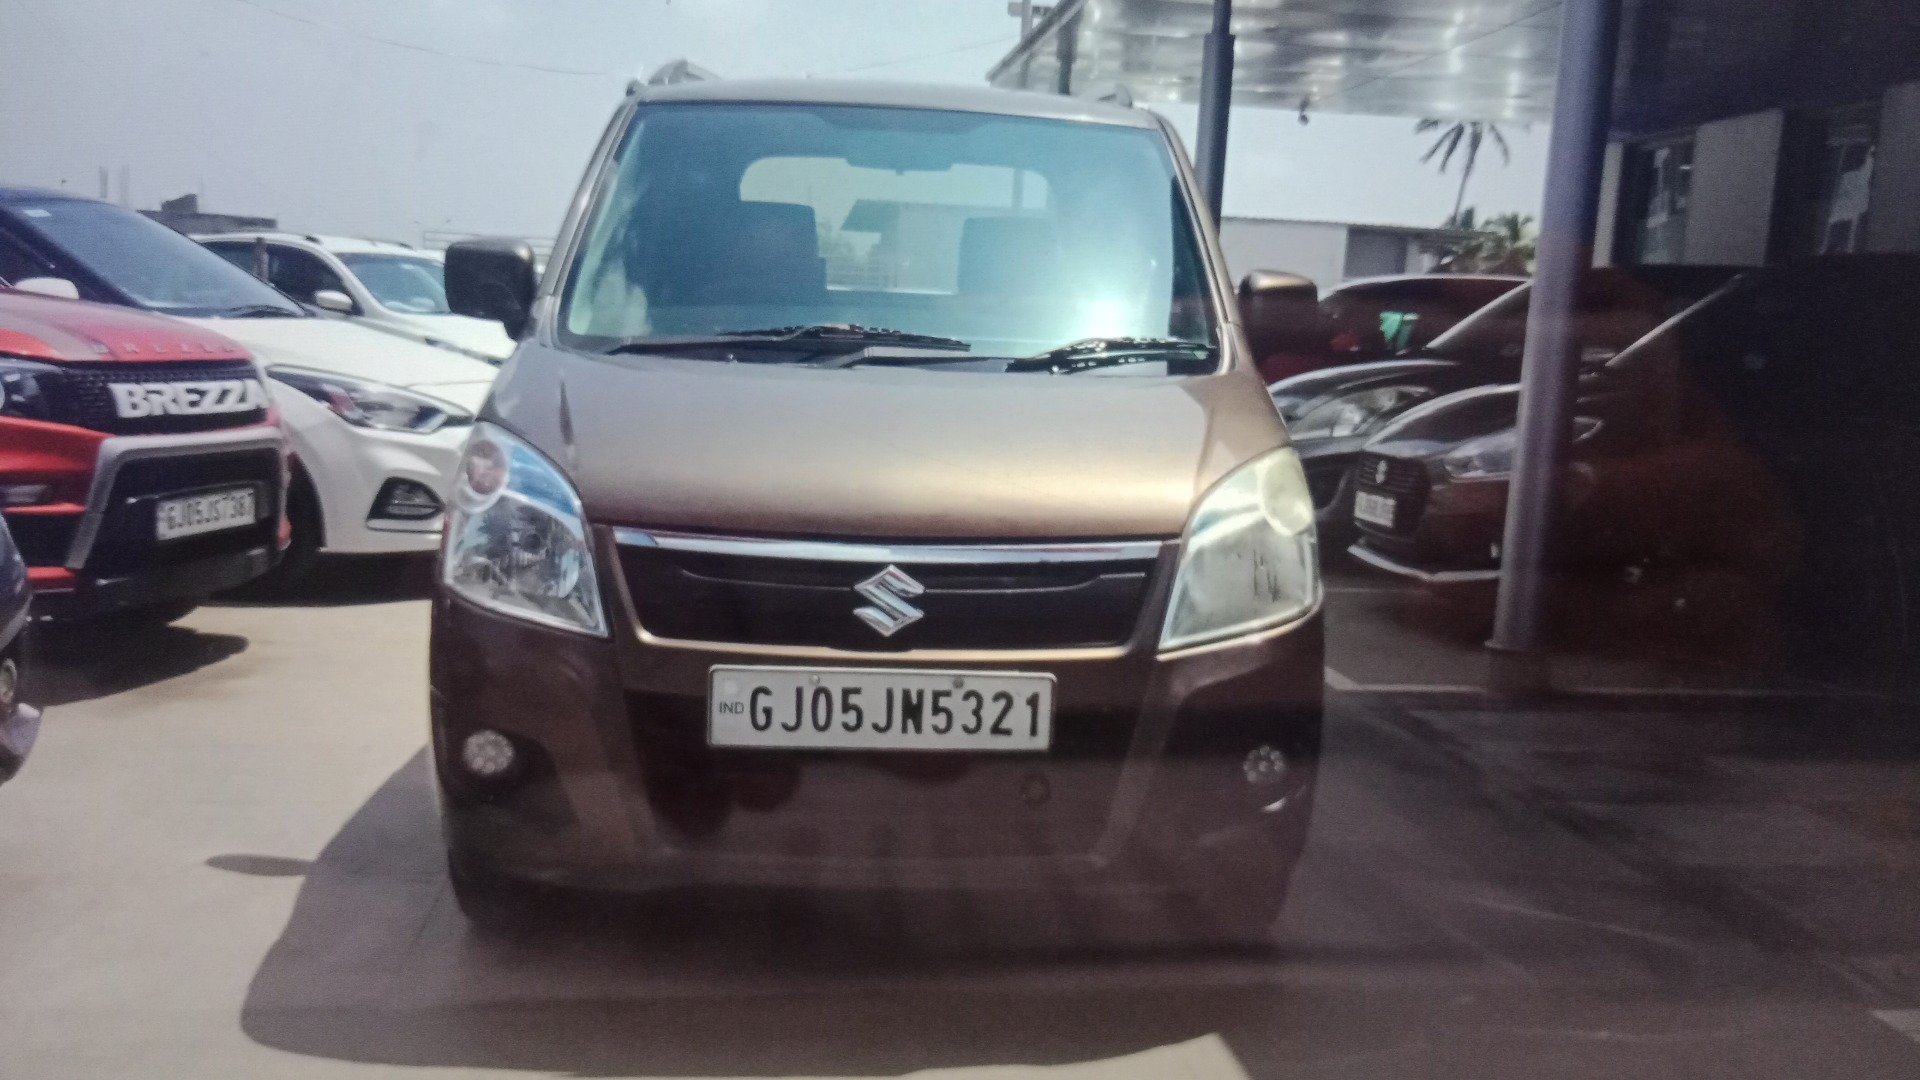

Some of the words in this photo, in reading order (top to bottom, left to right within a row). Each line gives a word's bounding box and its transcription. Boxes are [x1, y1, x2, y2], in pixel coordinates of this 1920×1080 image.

[109, 379, 269, 418] BREZZA
[719, 701, 745, 714] IND
[750, 686, 1040, 737] GJ05JN5321
